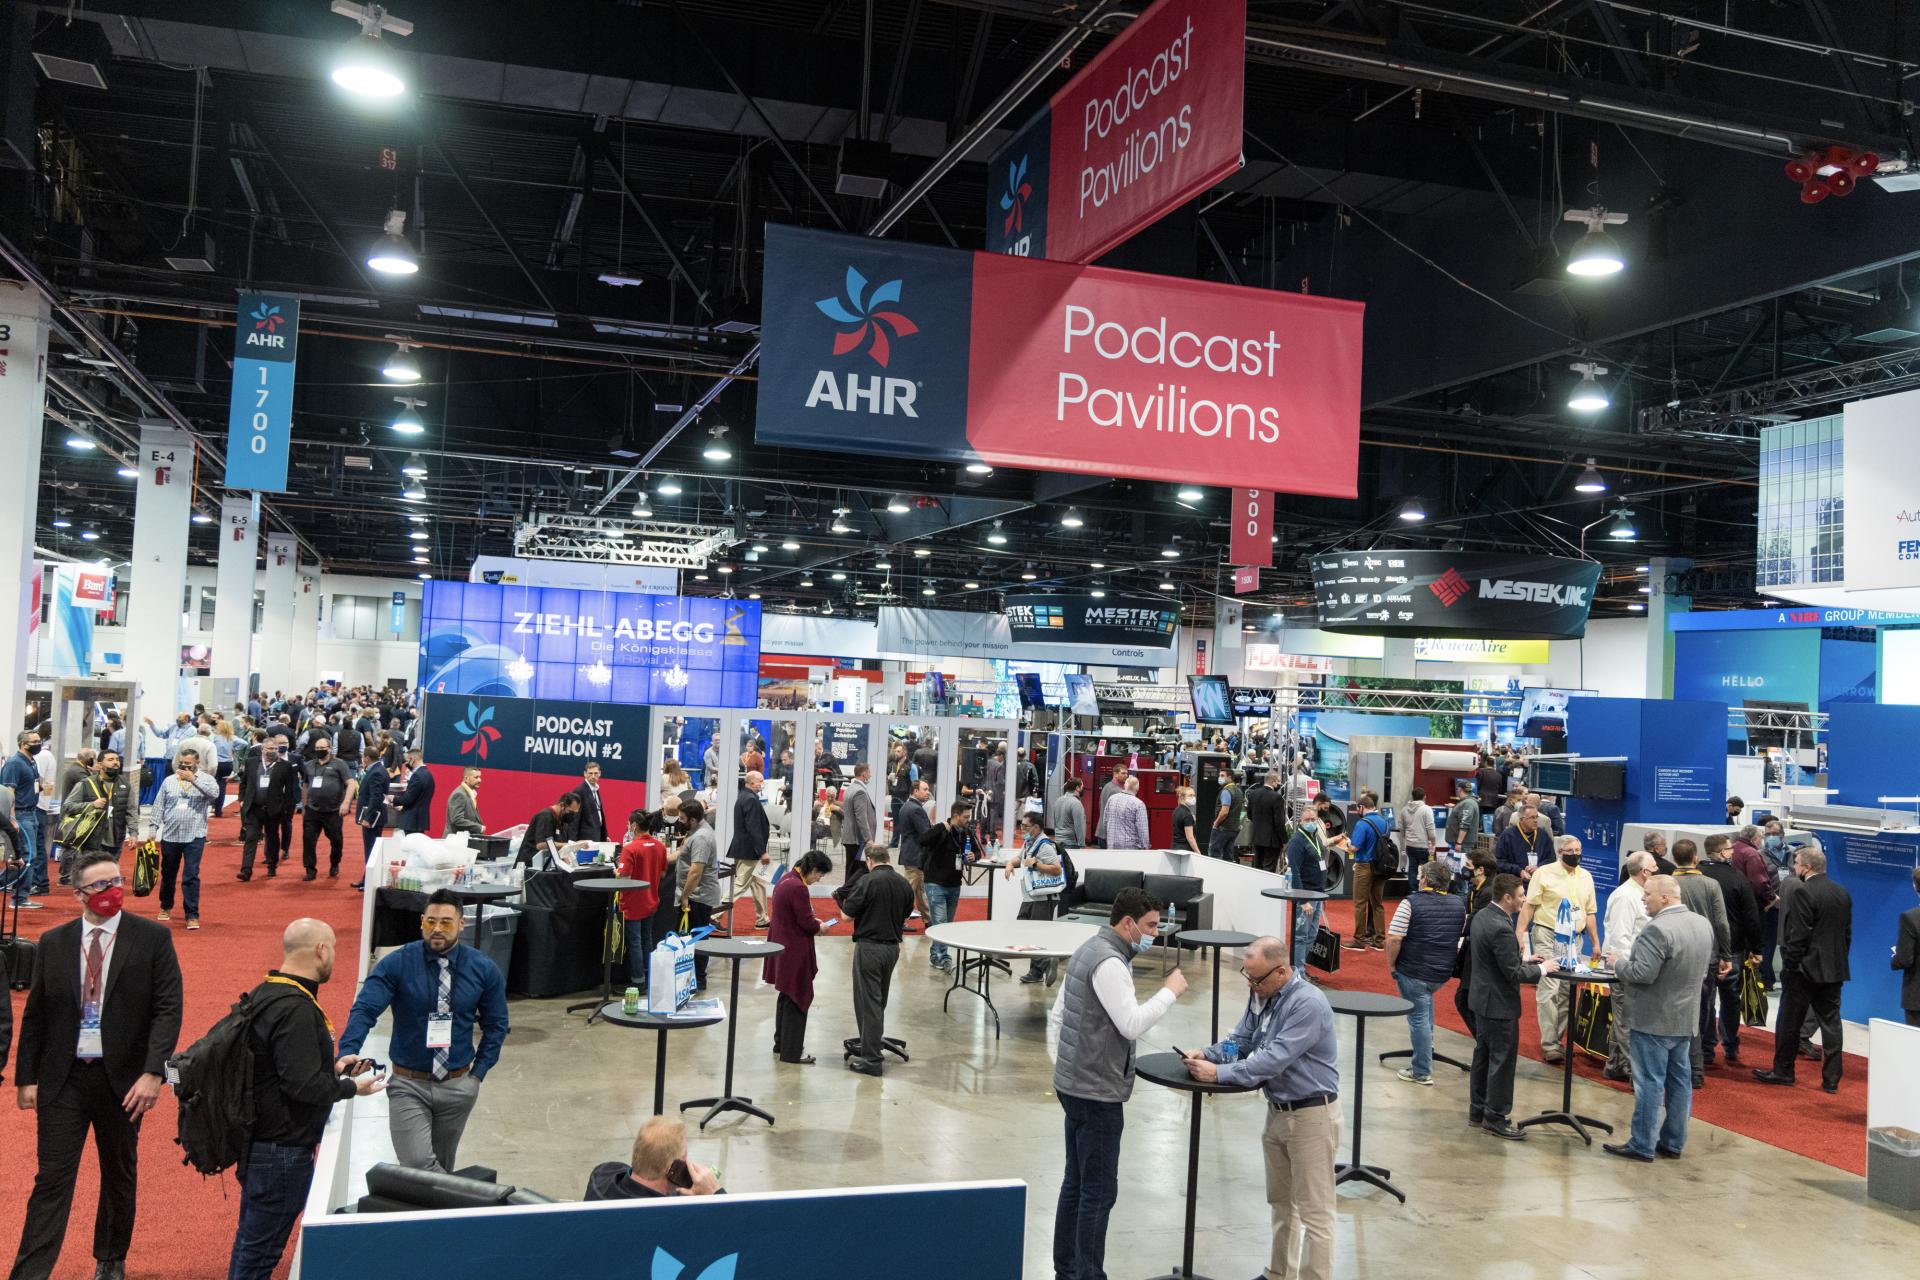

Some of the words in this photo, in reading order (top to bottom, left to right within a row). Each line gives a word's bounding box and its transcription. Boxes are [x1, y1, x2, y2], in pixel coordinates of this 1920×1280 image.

[1084, 15, 1194, 150] Podcast
[1079, 104, 1192, 218] Pavilions
[246, 332, 285, 348] AHR
[1064, 304, 1281, 377] Podcast
[805, 370, 919, 418] AHR
[251, 366, 269, 454] 1700
[1056, 371, 1280, 444] Pavilions
[152, 451, 175, 462] E-4
[232, 516, 247, 524] E-5
[1085, 607, 1160, 621] MESTEK
[1778, 612, 1786, 623] A
[1825, 609, 1865, 622] GROUP
[513, 612, 714, 643] ZIEHL-ABEGG
[1085, 618, 1158, 627] MACHINERY
[591, 641, 614, 651] Die
[620, 643, 713, 656] Königsklasse
[902, 637, 913, 645] The
[915, 640, 938, 648] power
[939, 640, 962, 648] behind
[982, 641, 1009, 650] mission
[1112, 648, 1144, 658] Controls
[1722, 676, 1764, 687] HELLO
[536, 716, 613, 736] PODCAST
[524, 736, 597, 757] PAVILION
[602, 742, 622, 759] #2
